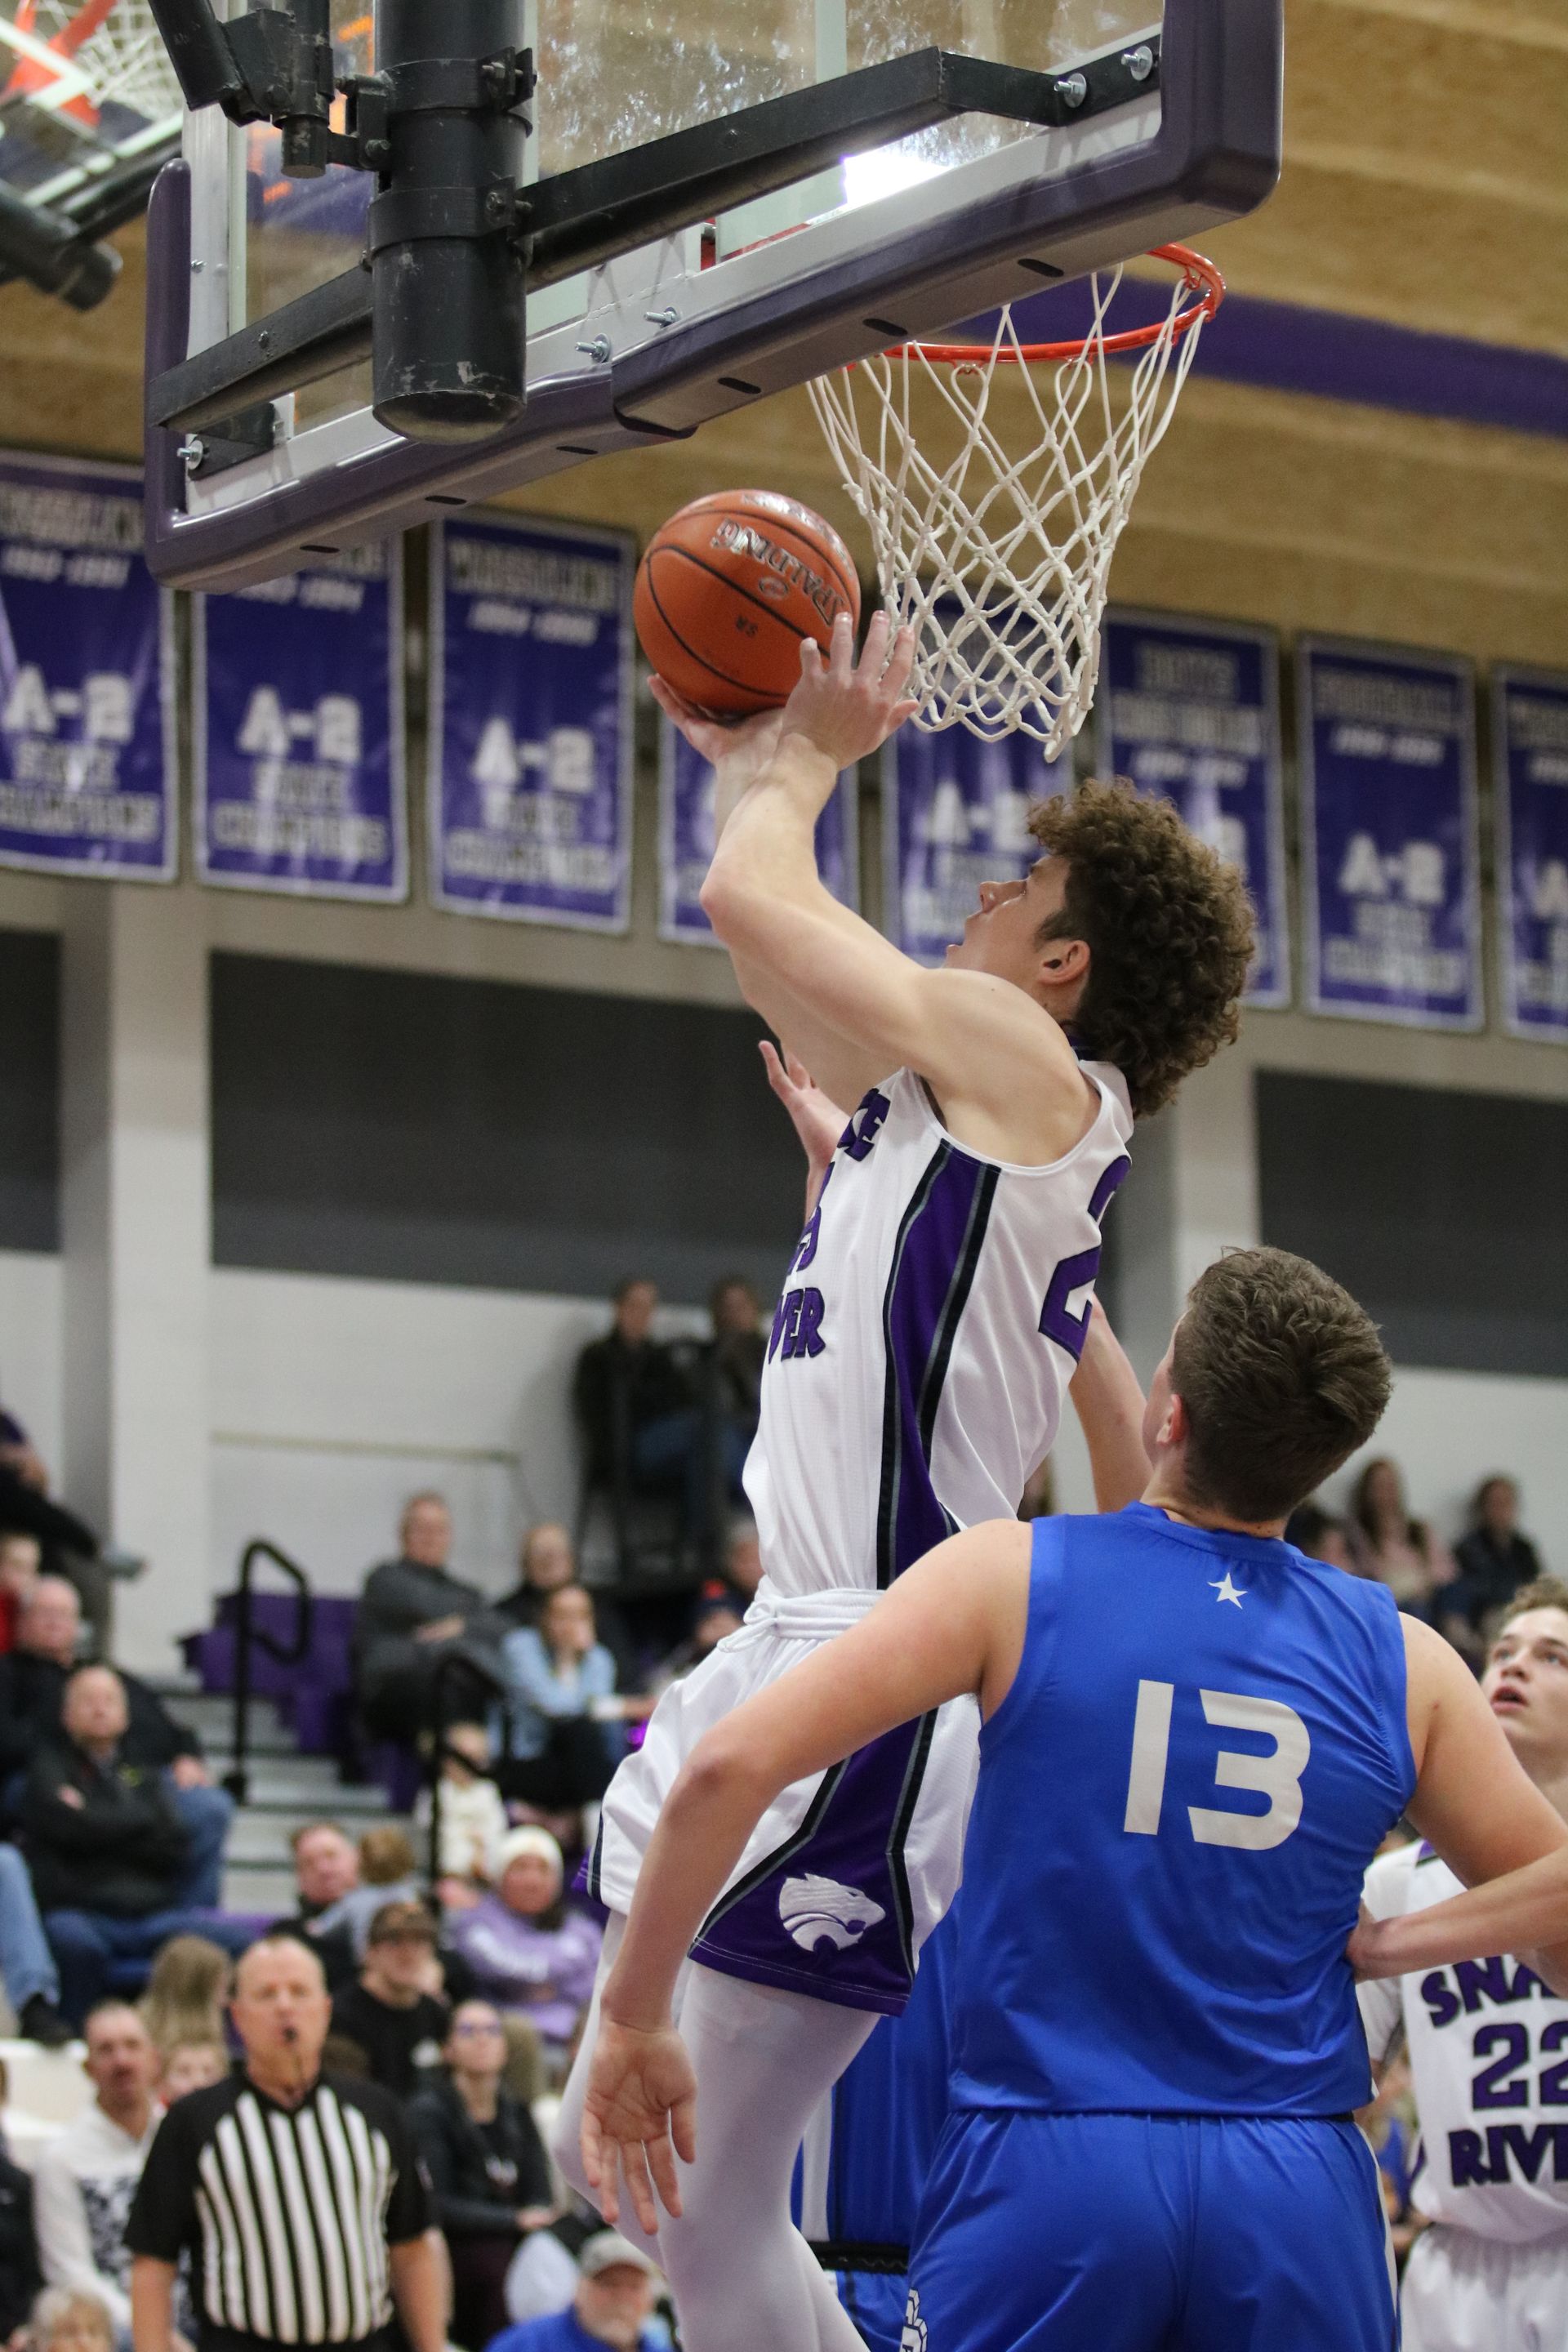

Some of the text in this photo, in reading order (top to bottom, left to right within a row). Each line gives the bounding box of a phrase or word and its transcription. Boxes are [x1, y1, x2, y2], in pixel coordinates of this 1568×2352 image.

[238, 687, 362, 764] A-2
[473, 719, 595, 793] A-2
[1124, 1679, 1311, 1851] 13
